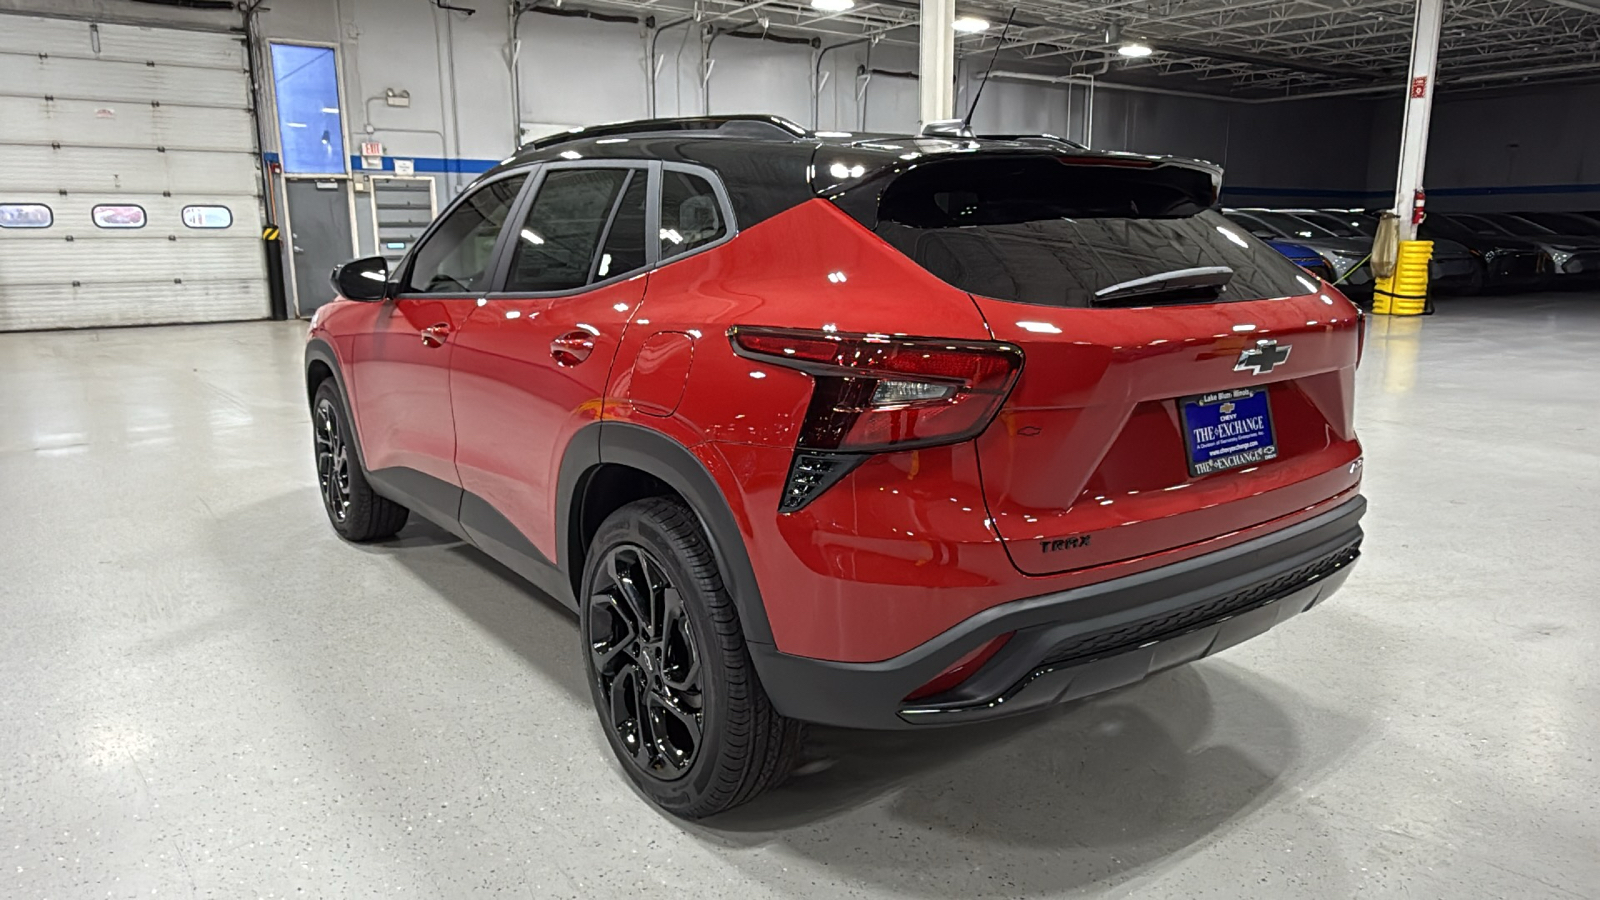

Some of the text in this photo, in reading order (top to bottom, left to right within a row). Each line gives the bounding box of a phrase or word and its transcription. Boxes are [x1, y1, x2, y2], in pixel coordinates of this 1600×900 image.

[365, 143, 380, 155] EXIT
[1203, 394, 1217, 403] Lake
[1220, 413, 1237, 422] CHEVY
[1193, 416, 1264, 443] THE EXCHANGE
[1194, 450, 1262, 475] THE EXCHANGE
[1040, 534, 1091, 553] TRAX
